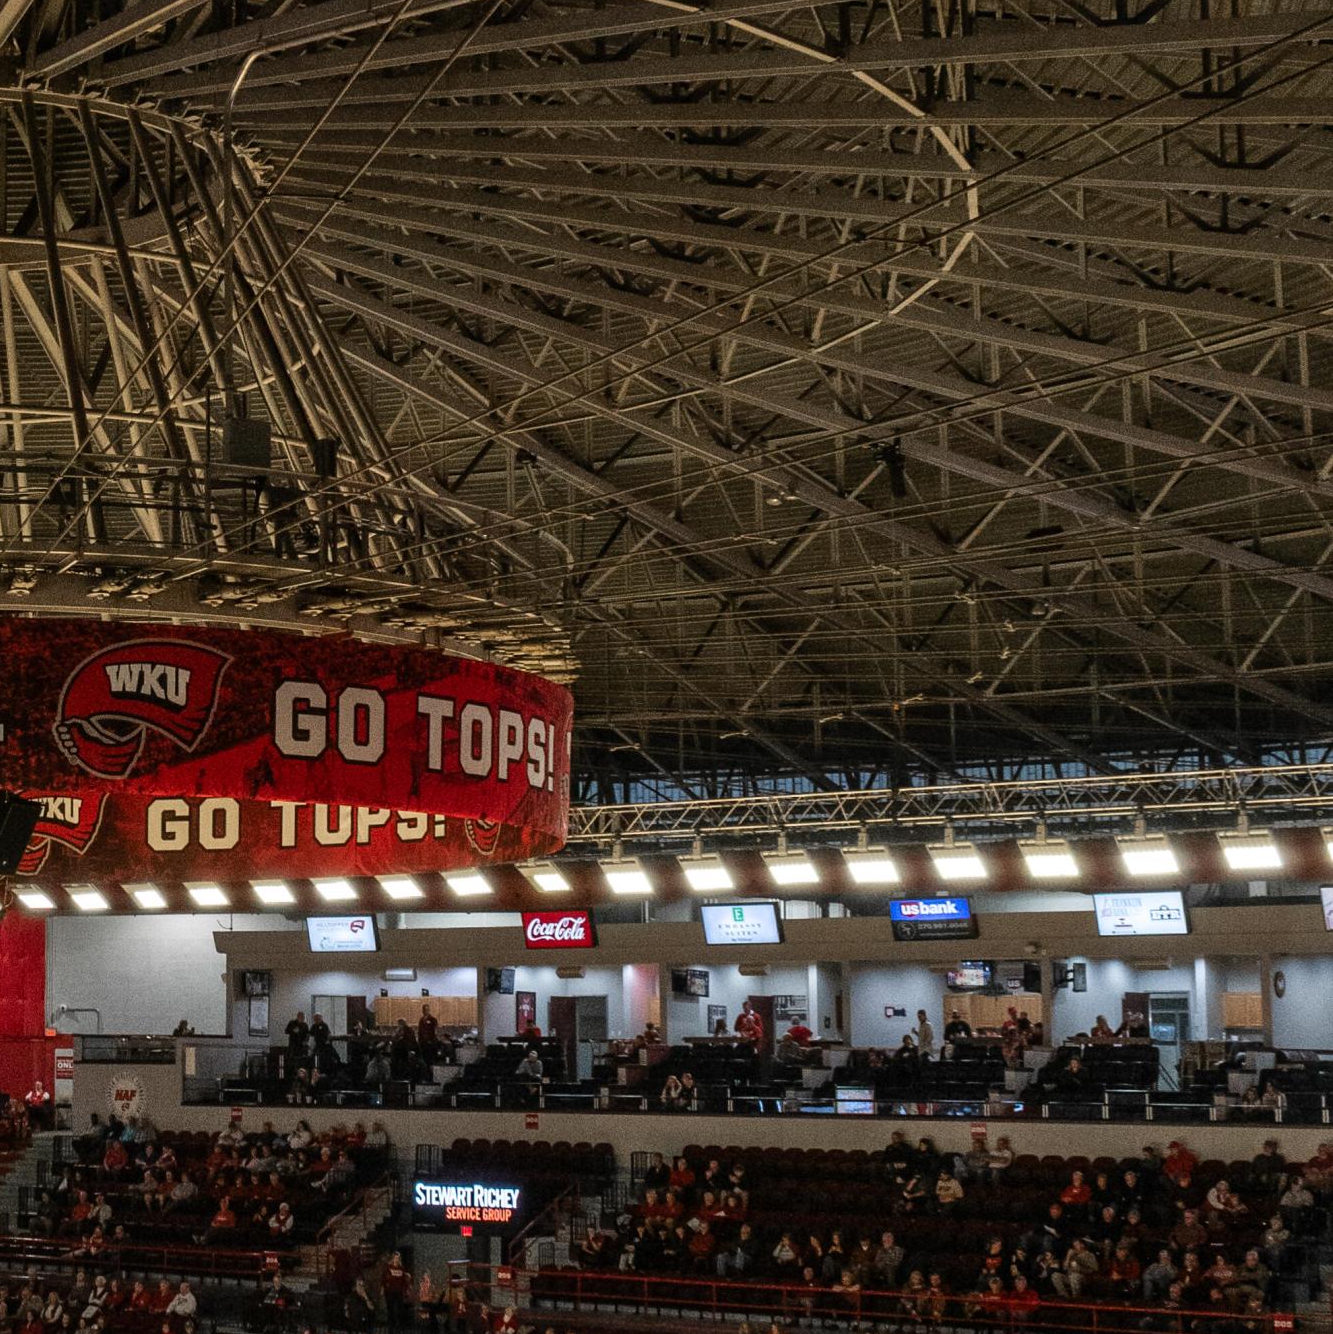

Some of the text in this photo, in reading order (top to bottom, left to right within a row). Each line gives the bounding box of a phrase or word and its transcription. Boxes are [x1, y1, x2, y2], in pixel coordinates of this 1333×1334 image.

[105, 663, 191, 709] WKU
[274, 680, 555, 792] GO TOPS!
[28, 797, 82, 825] KU
[147, 798, 240, 851] GO
[414, 1183, 519, 1210] STEWART RICHEY
[445, 1206, 512, 1223] SERVICE GROUP
